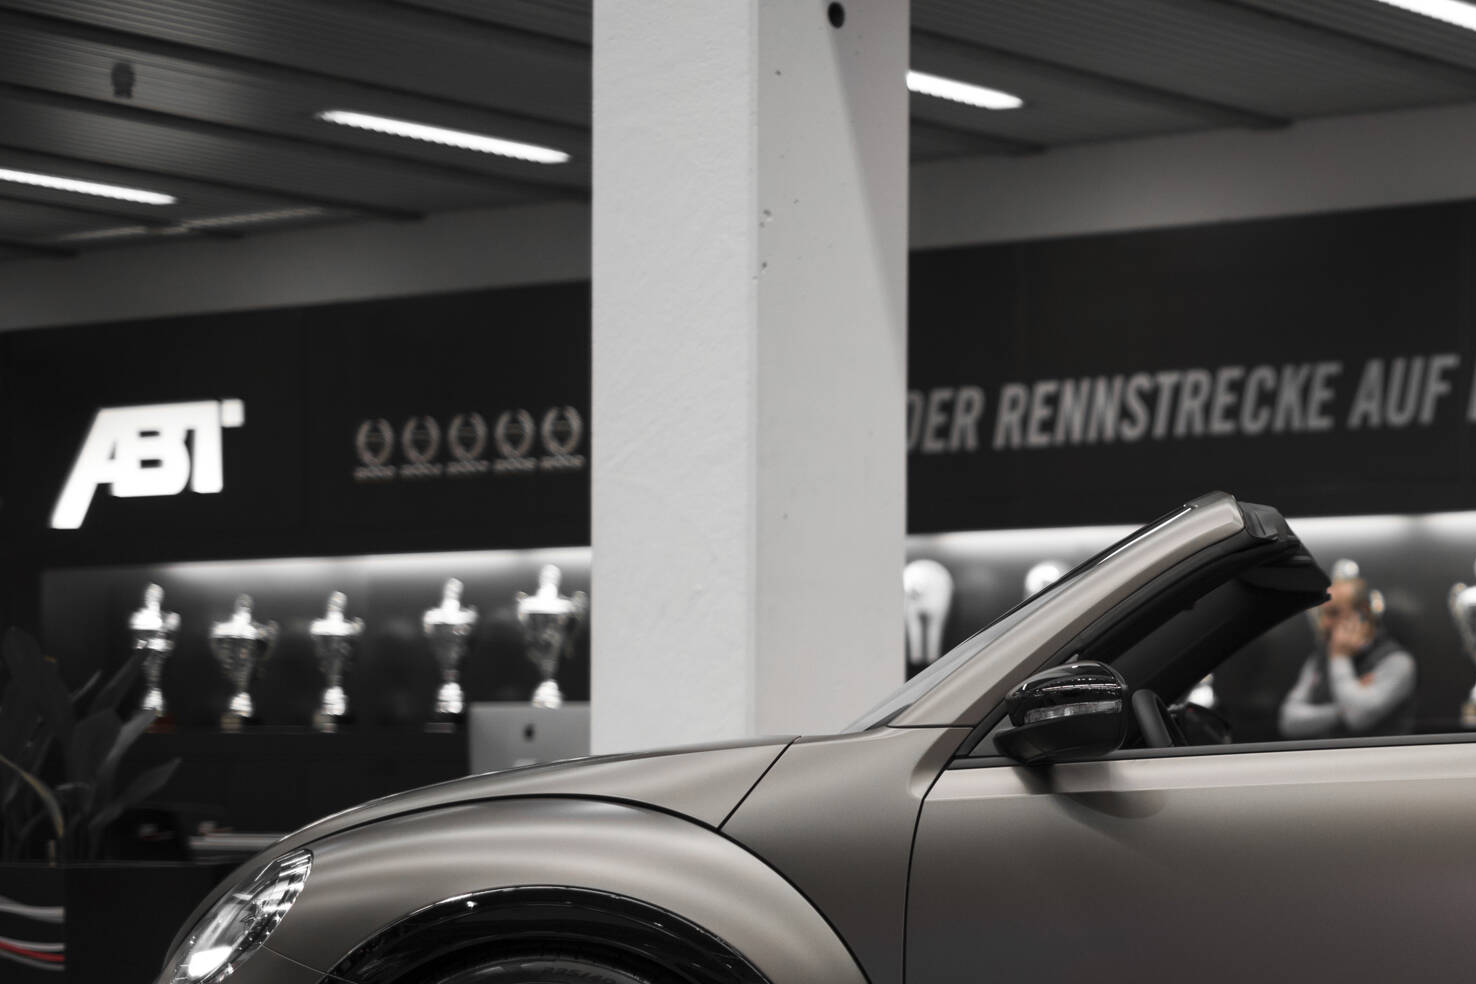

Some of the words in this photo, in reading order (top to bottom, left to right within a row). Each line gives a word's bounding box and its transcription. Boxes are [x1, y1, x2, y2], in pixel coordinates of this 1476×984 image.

[993, 362, 1342, 450] RENNSTRECKE
[1346, 353, 1459, 429] AUF
[50, 399, 244, 529] ABT
